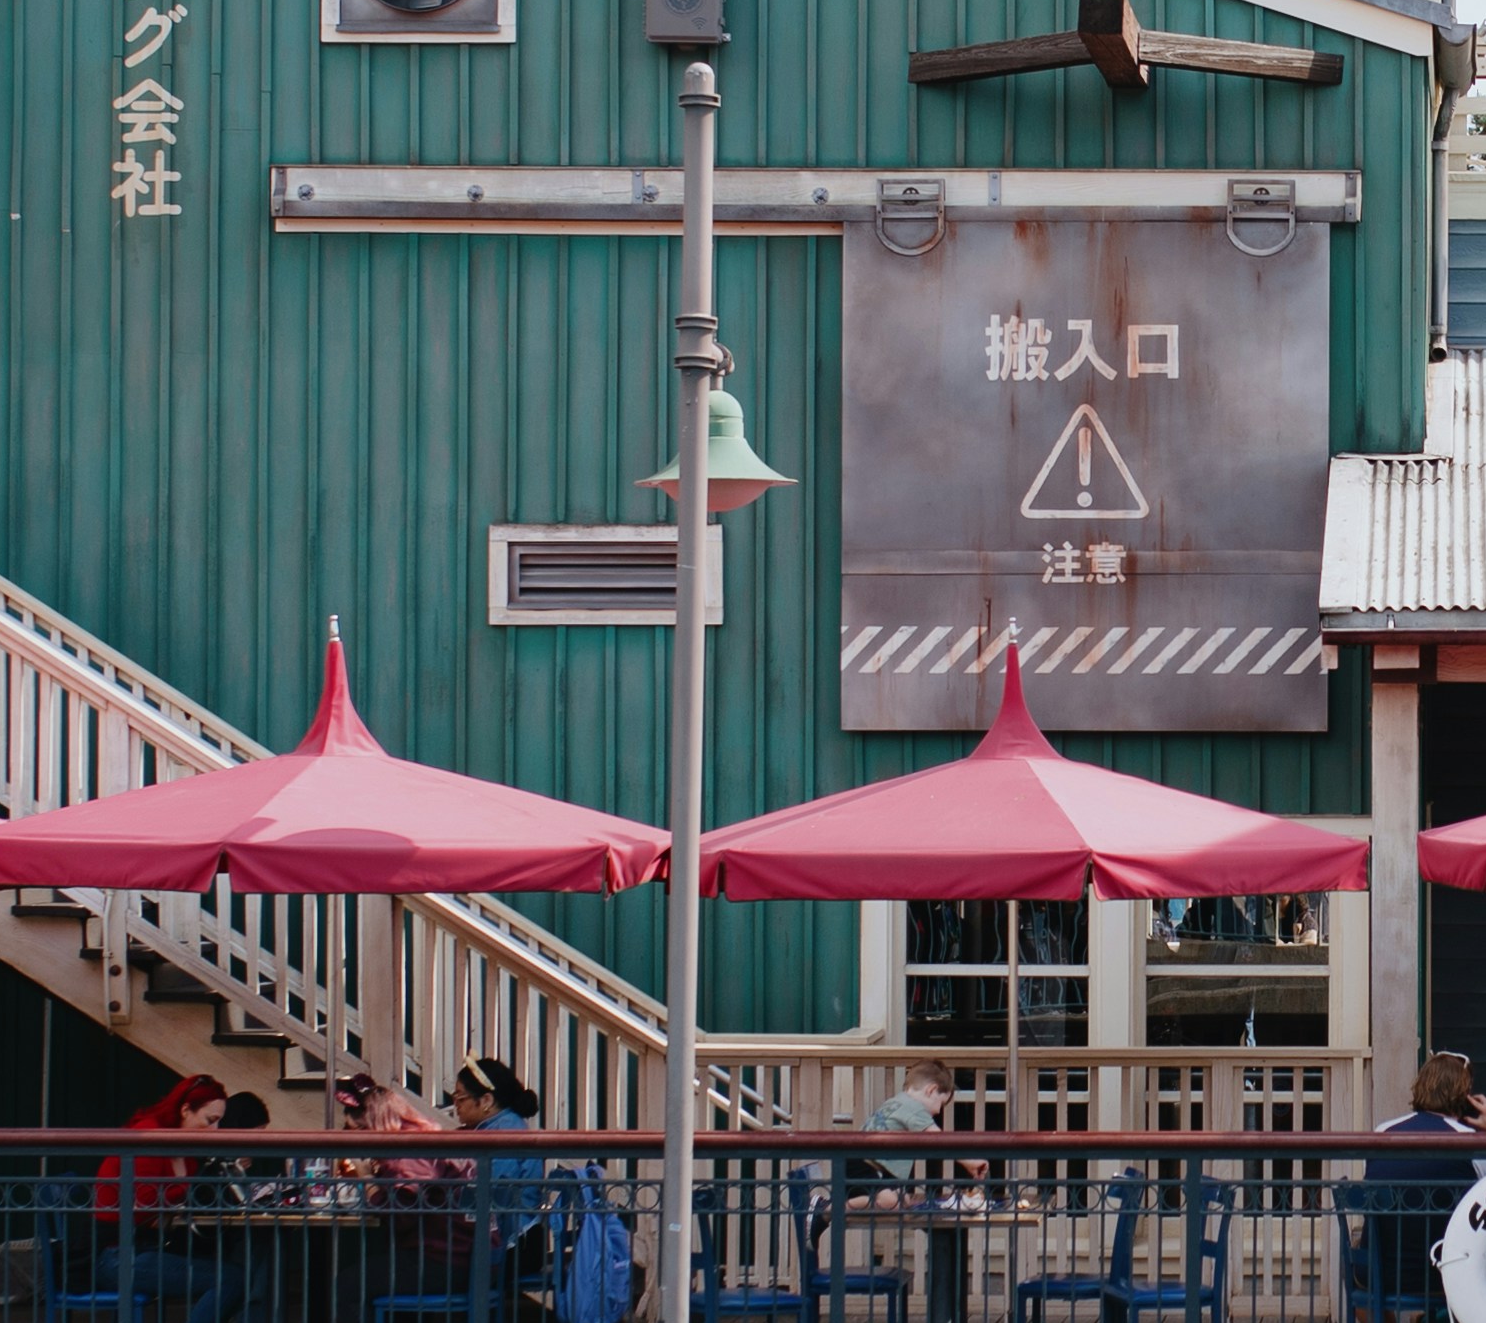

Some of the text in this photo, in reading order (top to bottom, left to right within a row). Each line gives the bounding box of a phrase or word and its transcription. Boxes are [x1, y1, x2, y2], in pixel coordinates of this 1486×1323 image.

[984, 313, 1180, 382] 搬入口
[1040, 541, 1128, 585] 注意
